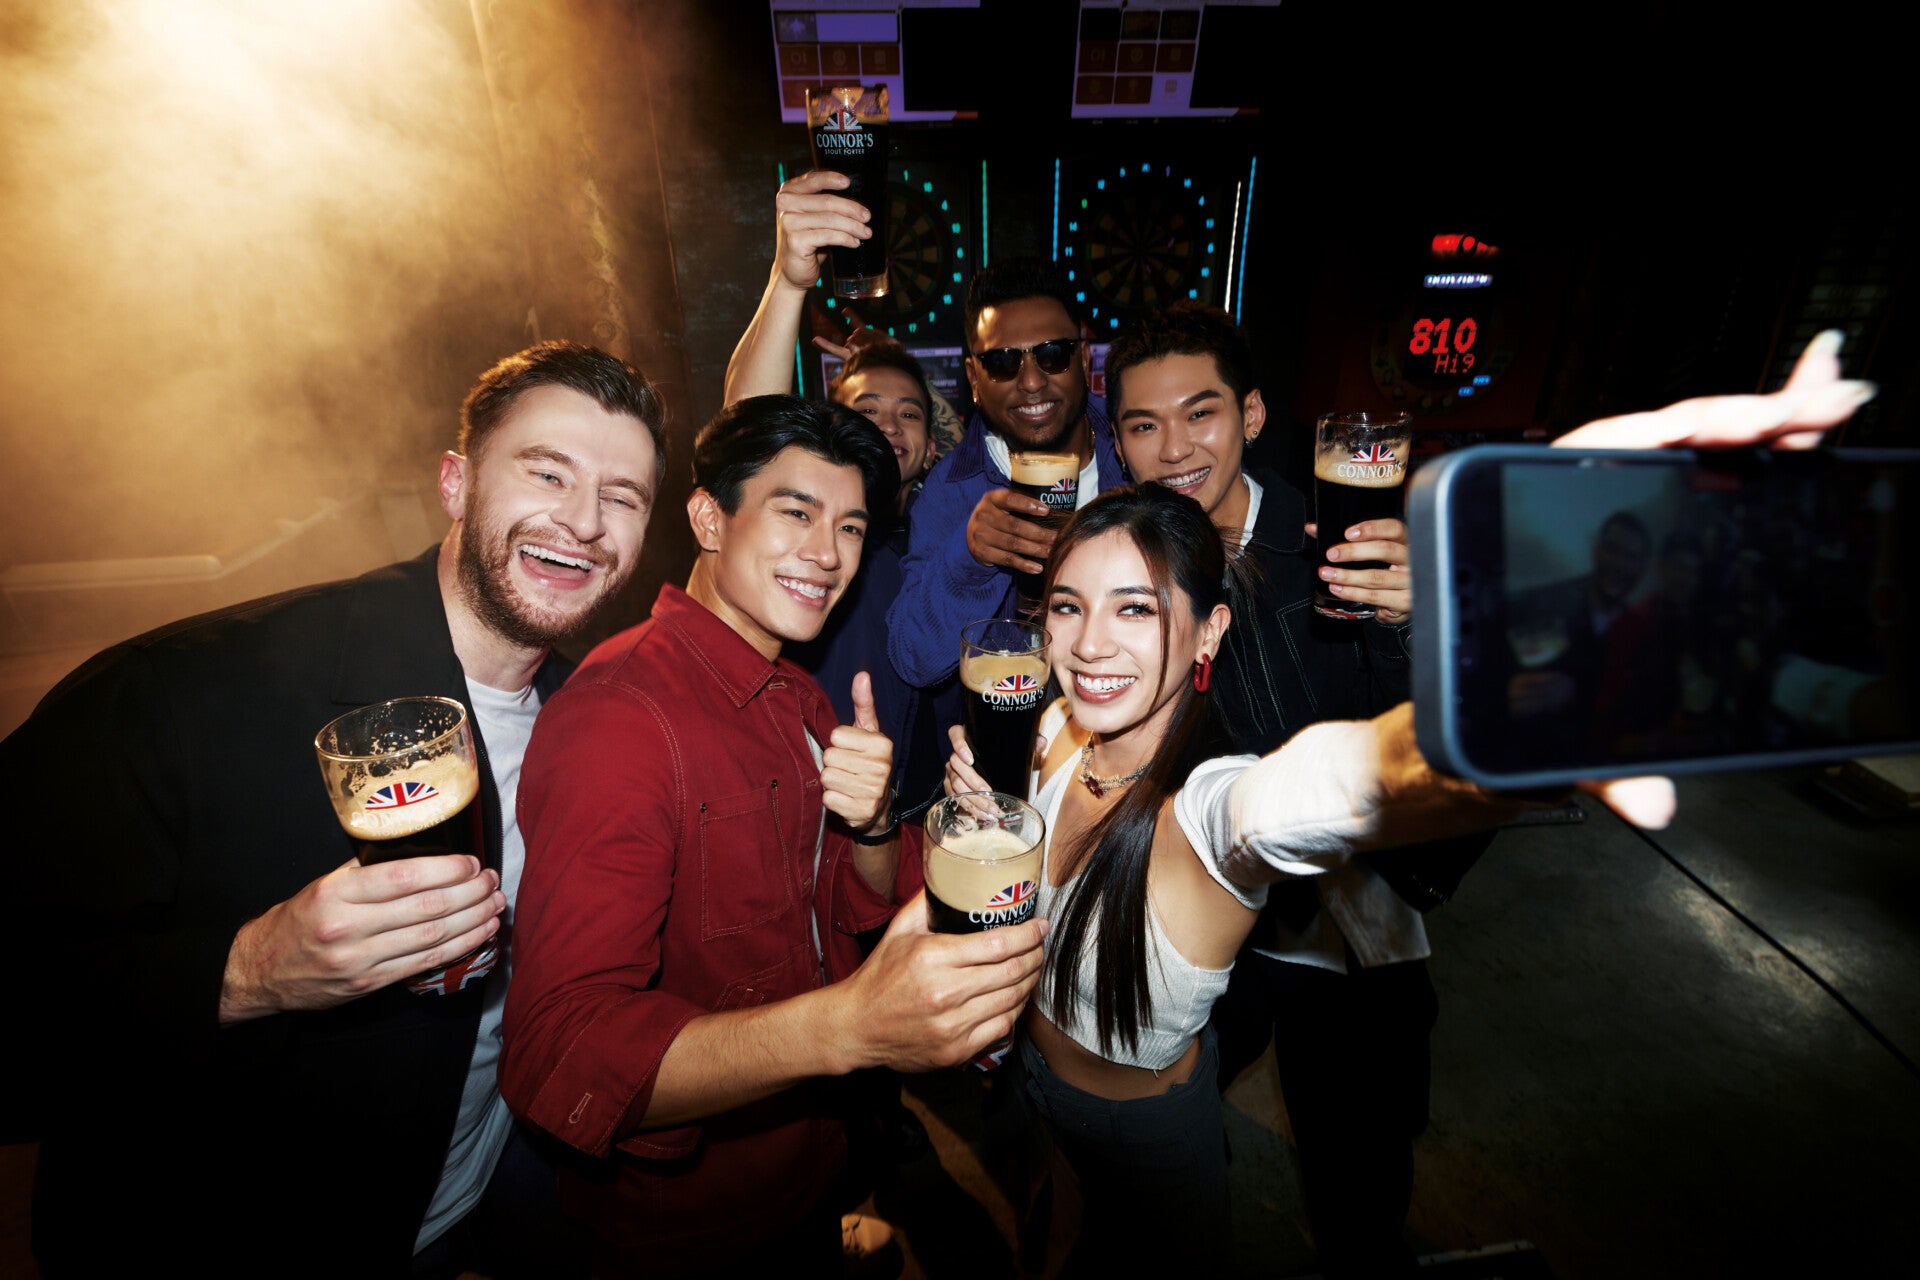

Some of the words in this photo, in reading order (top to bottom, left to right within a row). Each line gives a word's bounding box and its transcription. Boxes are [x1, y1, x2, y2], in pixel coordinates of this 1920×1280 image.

[816, 133, 874, 148] CONNOR'S
[1409, 317, 1477, 355] 810
[1336, 462, 1402, 479] CONNOR'S
[981, 686, 1044, 706] CONNOR'S
[1015, 702, 1036, 711] PORTER
